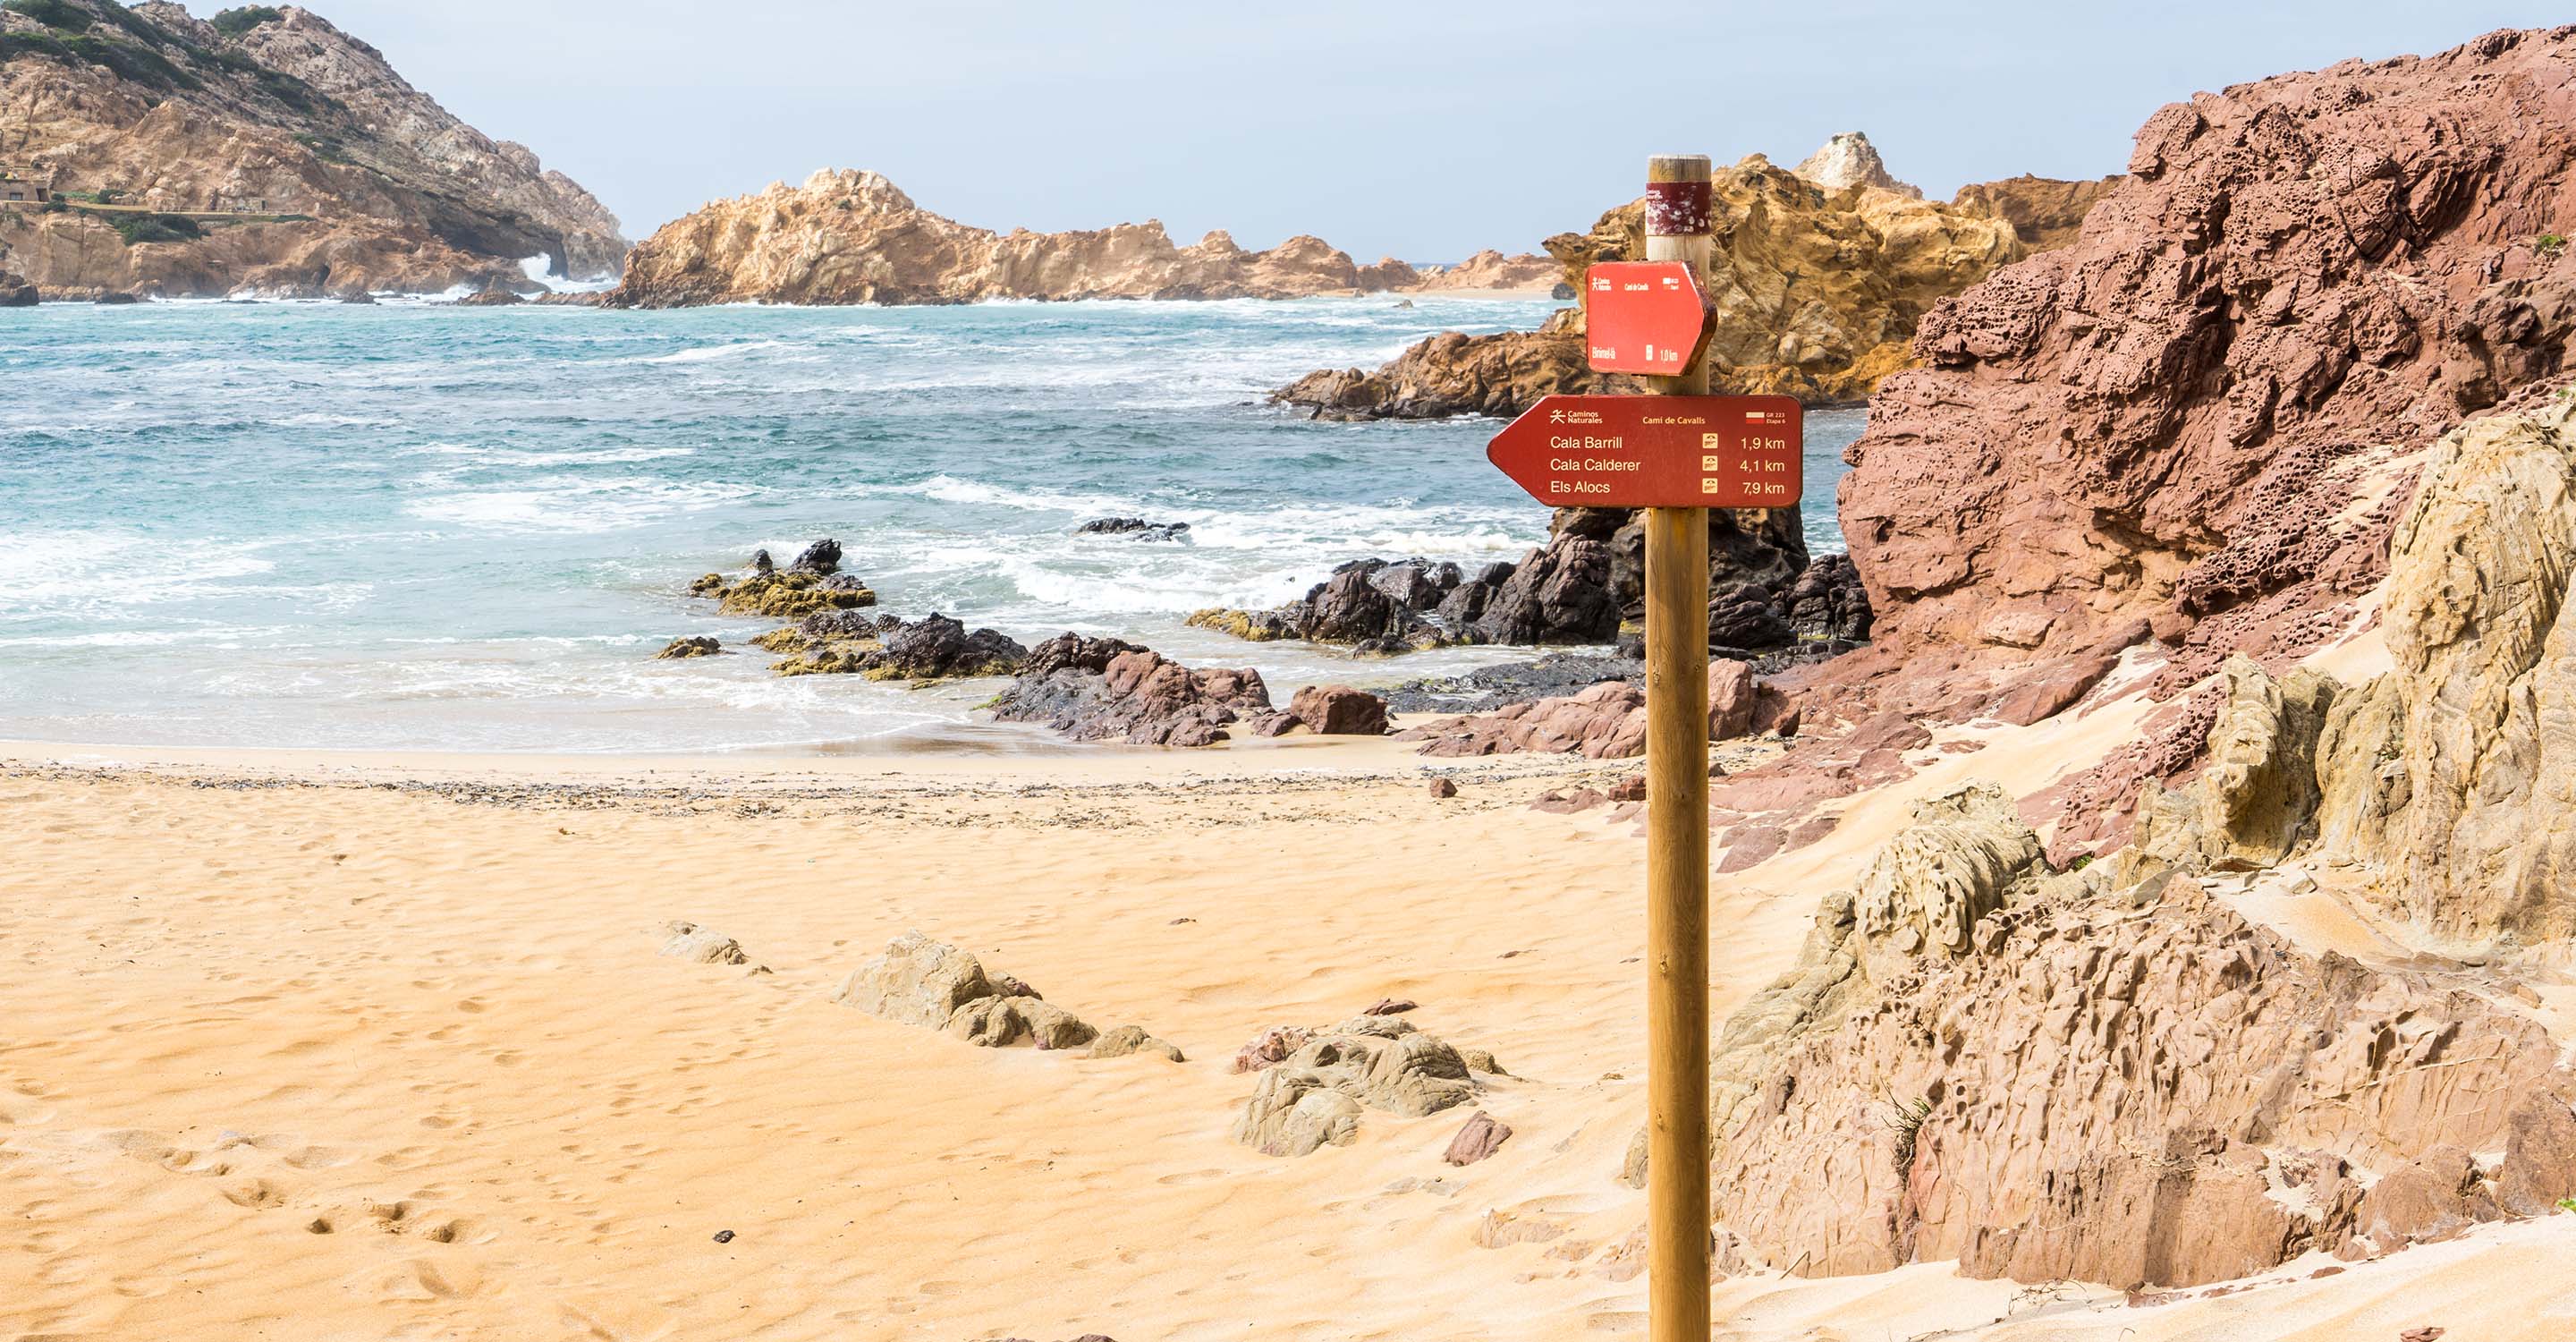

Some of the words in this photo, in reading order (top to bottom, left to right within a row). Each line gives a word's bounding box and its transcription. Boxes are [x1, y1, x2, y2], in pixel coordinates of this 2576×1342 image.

[1669, 349, 1678, 361] km
[1567, 410, 1598, 418] Caminos
[1642, 416, 1663, 424] Camí
[1665, 416, 1675, 424] de
[1677, 416, 1706, 424] Cavalls
[1550, 436, 1580, 449] Cala
[1584, 436, 1623, 449] Barrill
[1741, 437, 1761, 451] 1,9
[1765, 437, 1785, 449] km
[1550, 458, 1580, 471] Cala
[1584, 458, 1641, 471] Calderer
[1740, 459, 1759, 473] 4,1
[1765, 459, 1784, 471] km
[1551, 480, 1572, 493] Els
[1574, 480, 1611, 494] Alocs
[1742, 481, 1761, 496] 7,9
[1765, 481, 1784, 494] km
